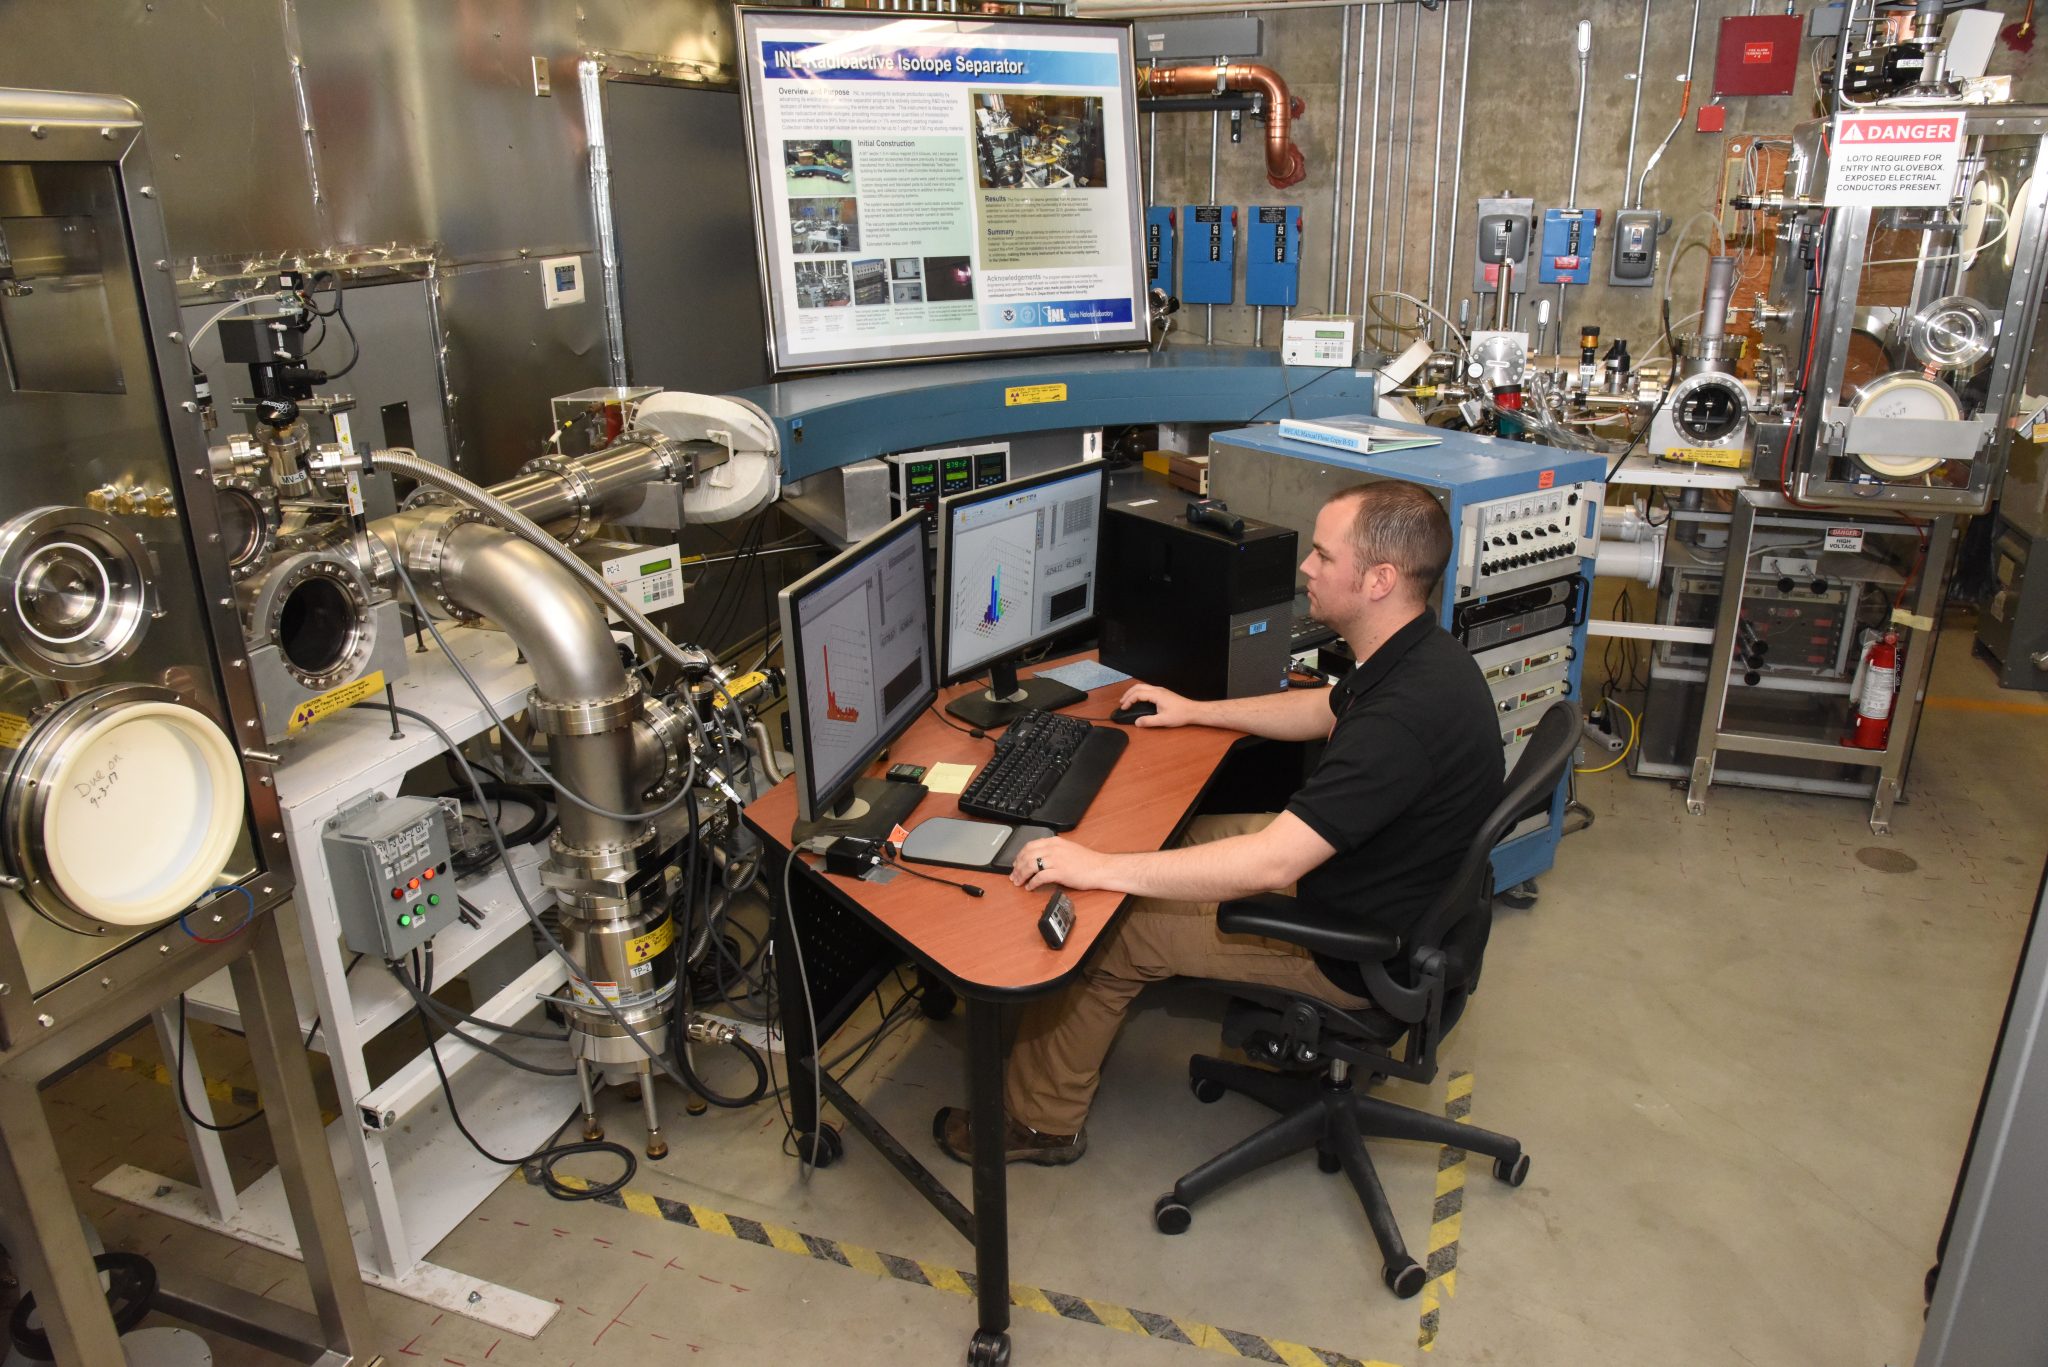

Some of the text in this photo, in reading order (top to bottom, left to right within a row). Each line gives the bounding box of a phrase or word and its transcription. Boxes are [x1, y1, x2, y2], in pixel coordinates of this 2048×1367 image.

[774, 51, 1025, 77] INL Radioactive Isotope Separator
[778, 87, 809, 96] Overview
[823, 88, 850, 97] Purpose
[1868, 124, 1952, 140] DANGER
[857, 139, 916, 147] Initial Construction
[1847, 154, 1874, 162] LO/TO
[1875, 154, 1920, 162] REQUIRED
[1840, 164, 1869, 172] ENTRY
[1870, 164, 1892, 172] INTO
[1845, 174, 1886, 182] EXPOSED
[987, 228, 1014, 236] Summary
[1213, 225, 1218, 234] ON
[986, 273, 1041, 282] Acknowledgements
[281, 472, 304, 484] MV-6
[606, 564, 620, 575] PC-2
[74, 770, 105, 798] Due
[633, 965, 650, 976] TP-2
